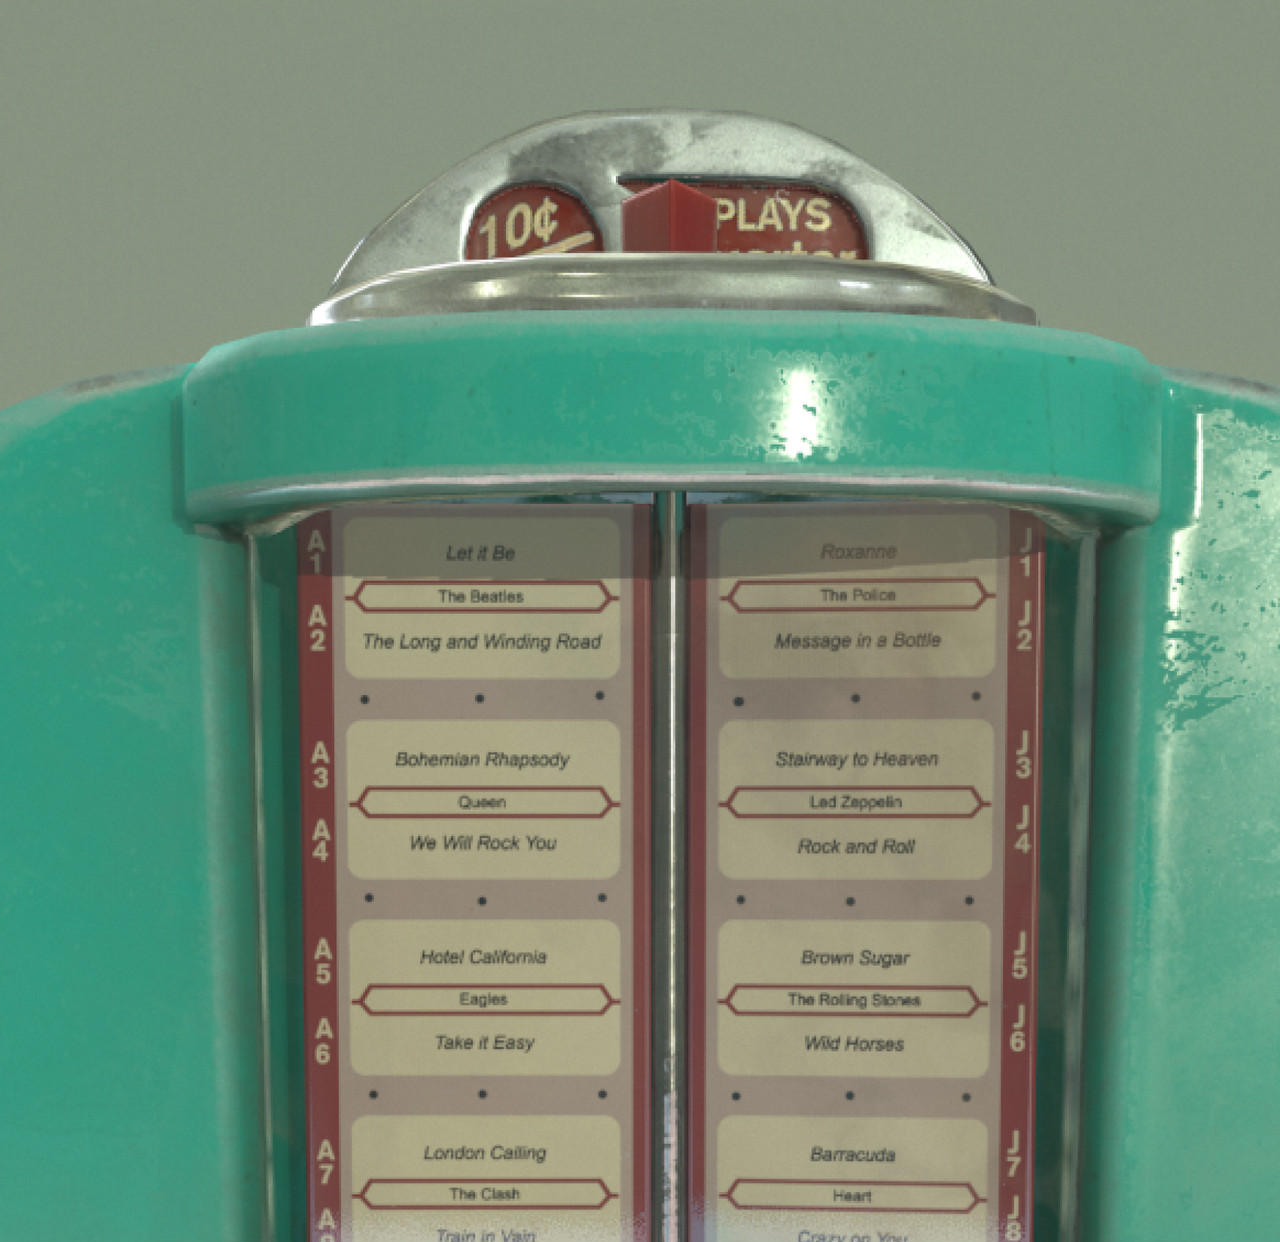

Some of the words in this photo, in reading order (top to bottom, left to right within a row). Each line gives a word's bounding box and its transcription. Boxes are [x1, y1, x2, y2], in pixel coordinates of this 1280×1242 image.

[716, 197, 832, 232] PLAYS
[479, 196, 560, 259] 10¢
[446, 545, 473, 562] Let
[476, 545, 487, 561] it
[492, 546, 516, 562] Be
[820, 543, 897, 560] Roxanne
[438, 589, 467, 604] The
[470, 589, 525, 604] Beatles
[820, 589, 848, 602] The
[852, 588, 896, 602] Police
[363, 633, 395, 650] The
[399, 633, 442, 653] Long
[446, 633, 479, 650] and
[483, 633, 551, 653] Winding
[556, 633, 603, 650] Road
[774, 633, 852, 652] Message
[857, 633, 871, 648] in
[877, 636, 887, 648] a
[892, 632, 942, 648] Bottle
[395, 752, 480, 767] Bohemian
[484, 752, 570, 770] Rhapsody
[776, 752, 849, 770] Stairway
[853, 752, 869, 767] to
[873, 752, 940, 767] Heaven
[457, 795, 506, 809] Queen
[809, 795, 837, 809] Led
[841, 795, 903, 812] Zeppelin
[410, 835, 437, 851] We
[443, 835, 473, 851] Will
[477, 835, 520, 851] Rock
[526, 835, 558, 851] You
[797, 838, 841, 854] Rock
[845, 838, 878, 854] and
[882, 838, 916, 854] Roll
[420, 949, 465, 965] Hotel
[470, 949, 548, 965] California
[800, 950, 854, 965] Brown
[859, 950, 911, 968] Sugar
[459, 992, 509, 1008] Eagles
[788, 993, 815, 1006] The
[819, 993, 868, 1009] Rolling
[872, 993, 922, 1007] Stones
[435, 1035, 474, 1051] Take
[478, 1035, 488, 1050] it
[493, 1035, 535, 1054] Easy
[804, 1035, 841, 1051] Wild
[845, 1035, 905, 1051] Horses
[423, 1145, 485, 1162] London
[490, 1145, 547, 1164] Calling
[810, 1146, 896, 1163] Barracuda
[449, 1187, 477, 1201] The
[481, 1187, 520, 1201] Clash
[832, 1189, 873, 1204] Heart
